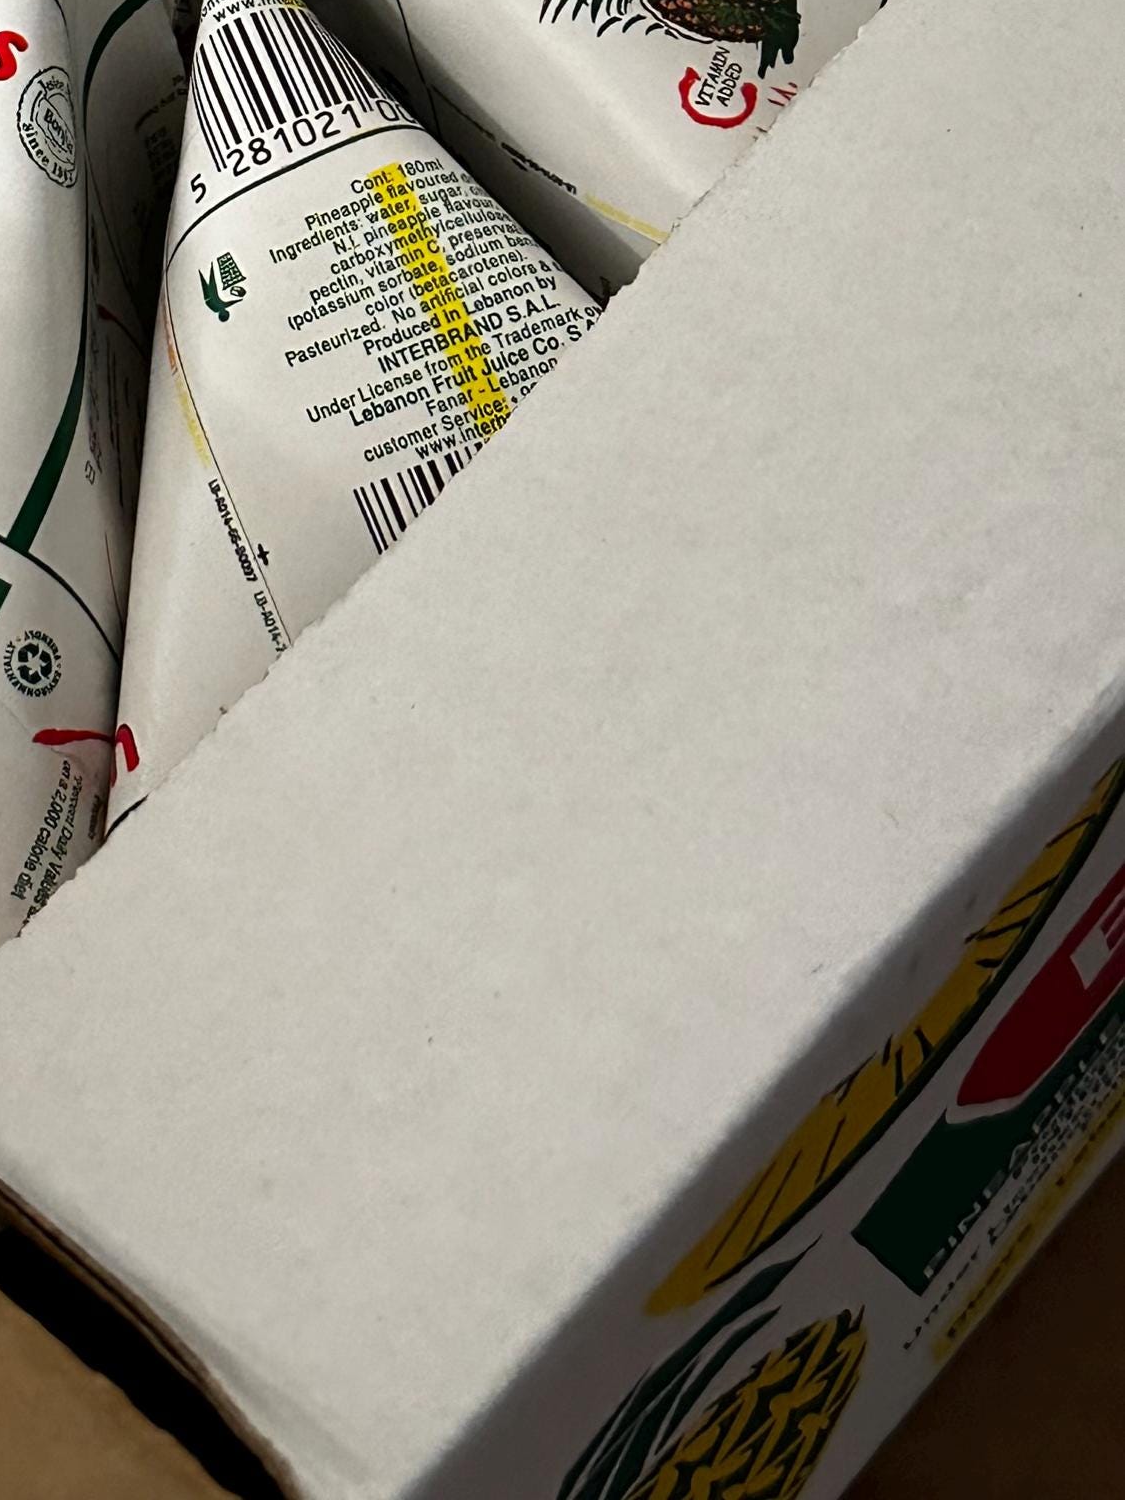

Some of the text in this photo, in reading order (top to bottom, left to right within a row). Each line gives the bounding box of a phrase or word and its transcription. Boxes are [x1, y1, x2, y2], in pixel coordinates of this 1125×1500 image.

[695, 45, 730, 106] VITAMIN
[716, 63, 743, 107] ADDED
[191, 102, 361, 203] 5 281021
[397, 158, 444, 177] 180ml
[269, 218, 363, 263] Ingredients:
[366, 199, 416, 224] water,
[305, 172, 459, 230] Pineapple flavoured
[363, 206, 442, 245] pineapple
[287, 286, 375, 330] (potassium
[378, 260, 443, 292] sorbate,
[446, 238, 503, 266] sodium
[309, 273, 364, 304] pectin,
[365, 247, 425, 278] vitamin
[365, 290, 404, 317] color
[285, 316, 386, 367] Pasteurized.
[391, 305, 416, 324] No
[420, 277, 484, 314] artificial
[488, 260, 538, 286] colors
[363, 275, 557, 355] Produced in Lebanon by
[377, 313, 503, 374] INTERBRAND
[306, 394, 356, 423] Under
[357, 369, 423, 403] License
[424, 353, 463, 377] from
[464, 342, 492, 360] the
[492, 308, 584, 349] Trademark
[349, 385, 430, 427] Lebanon
[432, 365, 478, 394] Fruit
[482, 348, 529, 376] Juice
[532, 336, 565, 355] Co.
[364, 398, 509, 462] customer Service:
[426, 388, 473, 417] Fanar
